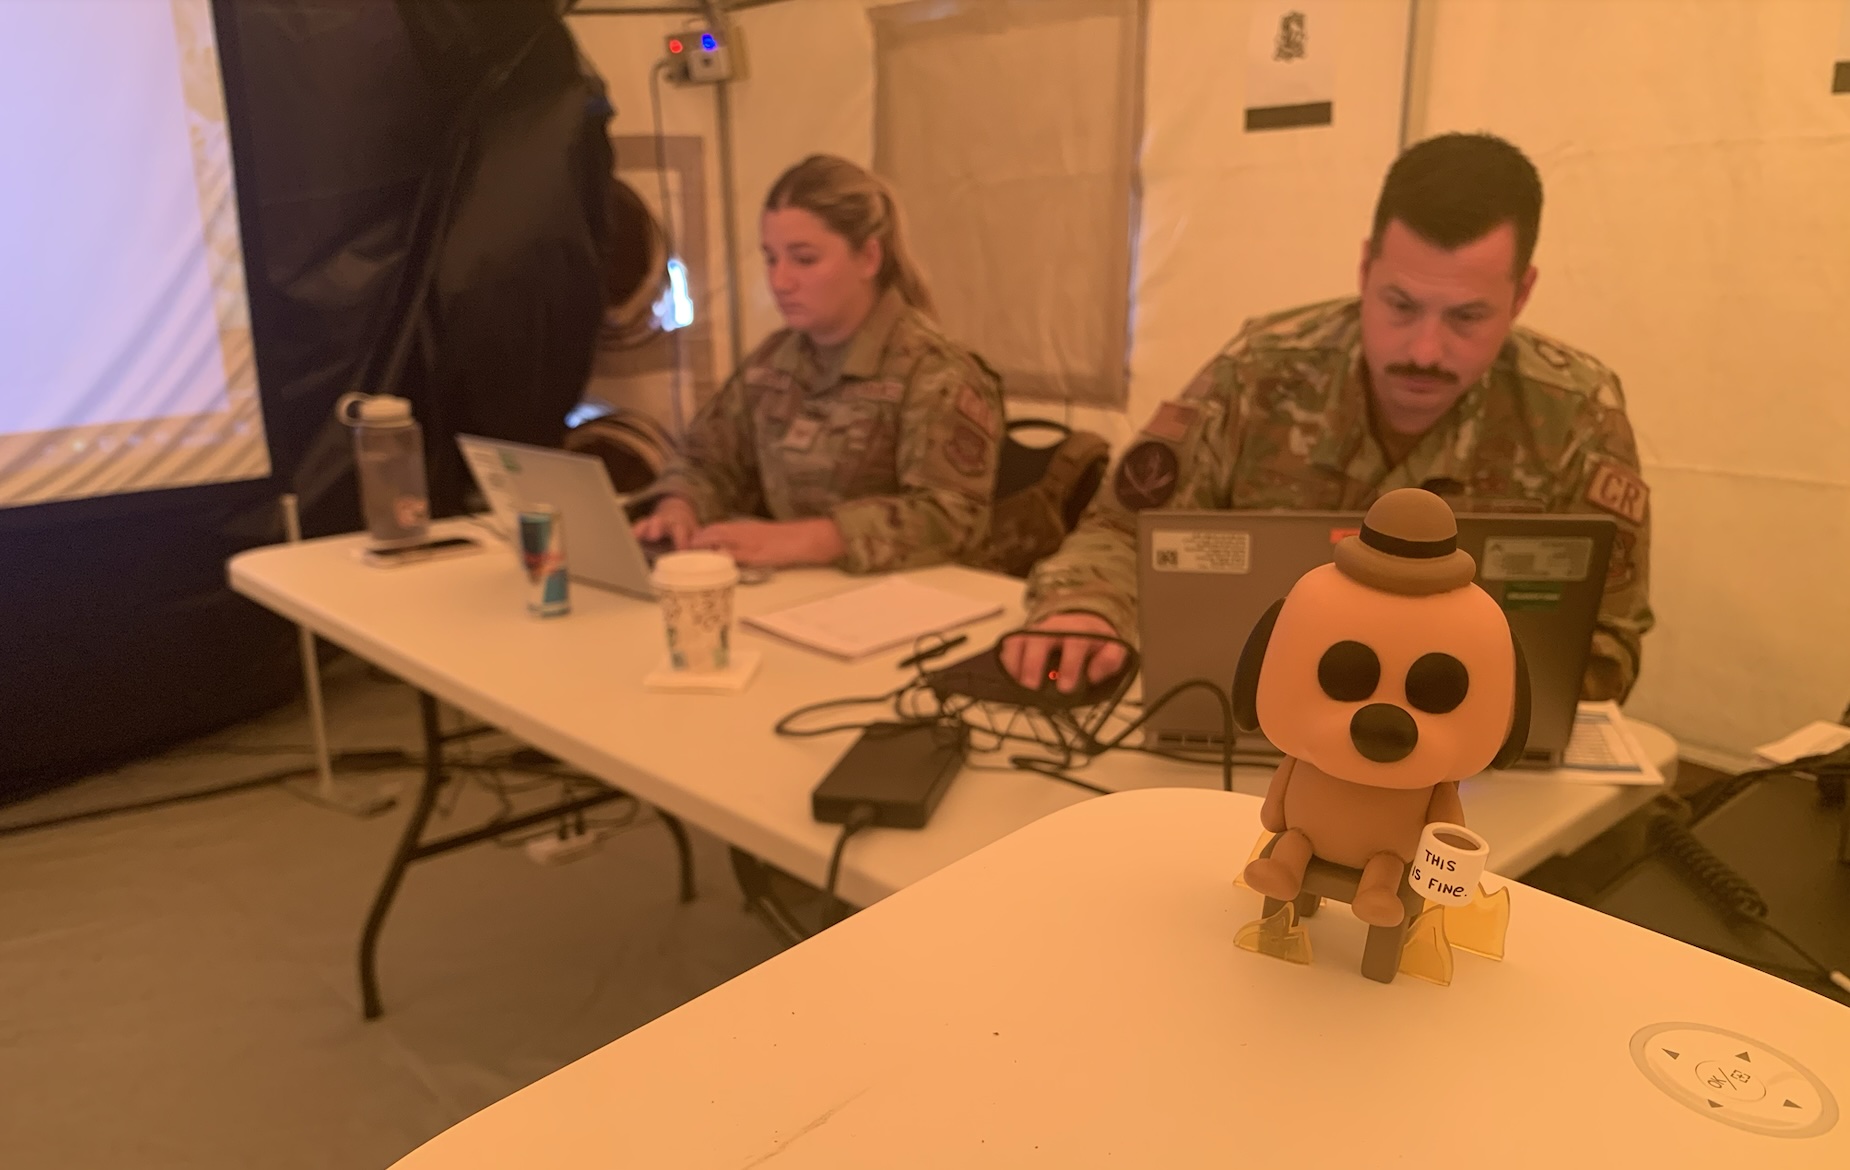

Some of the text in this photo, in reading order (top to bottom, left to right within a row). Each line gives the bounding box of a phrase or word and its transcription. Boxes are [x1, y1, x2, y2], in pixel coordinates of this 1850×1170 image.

[1601, 472, 1640, 516] CR
[1425, 849, 1456, 871] THIS
[1412, 865, 1421, 880] IS
